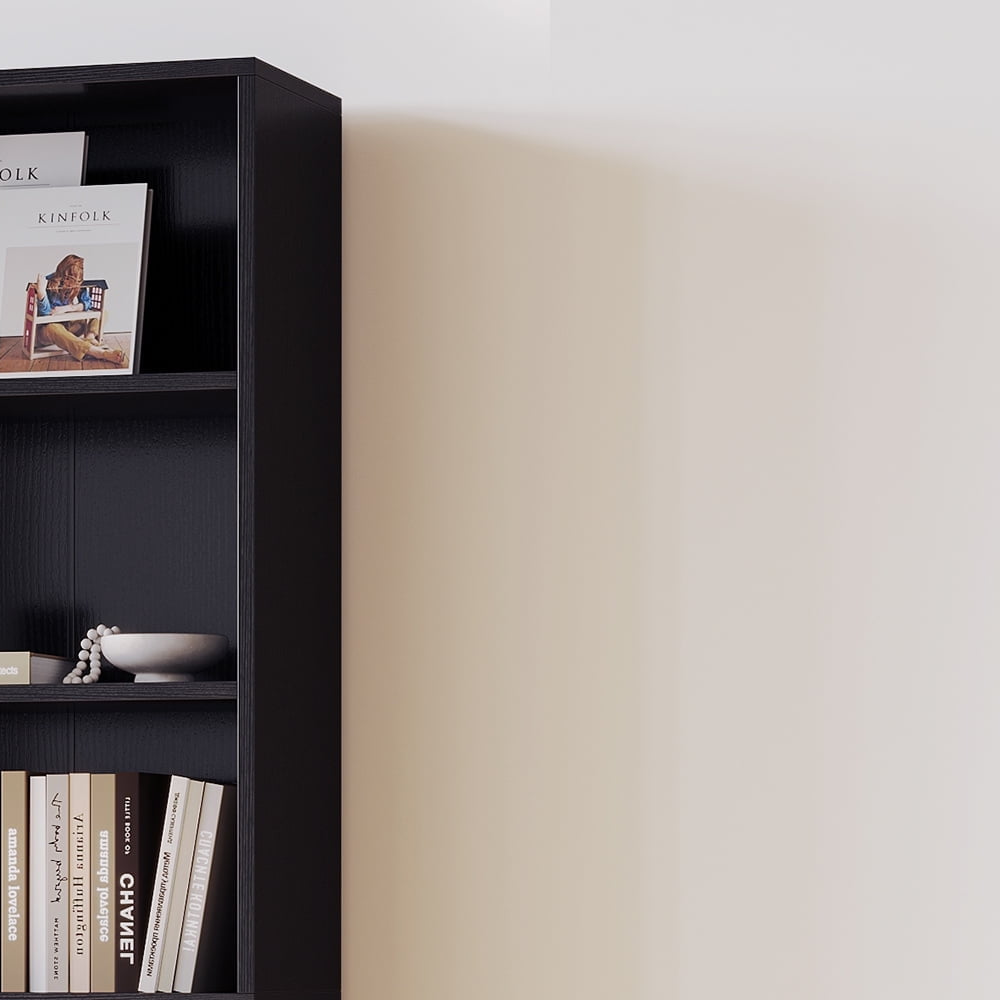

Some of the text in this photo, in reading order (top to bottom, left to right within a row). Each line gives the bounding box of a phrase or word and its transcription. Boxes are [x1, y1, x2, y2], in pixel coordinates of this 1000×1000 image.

[38, 210, 111, 223] KINFOLK
[8, 828, 21, 941] amanda lovelace
